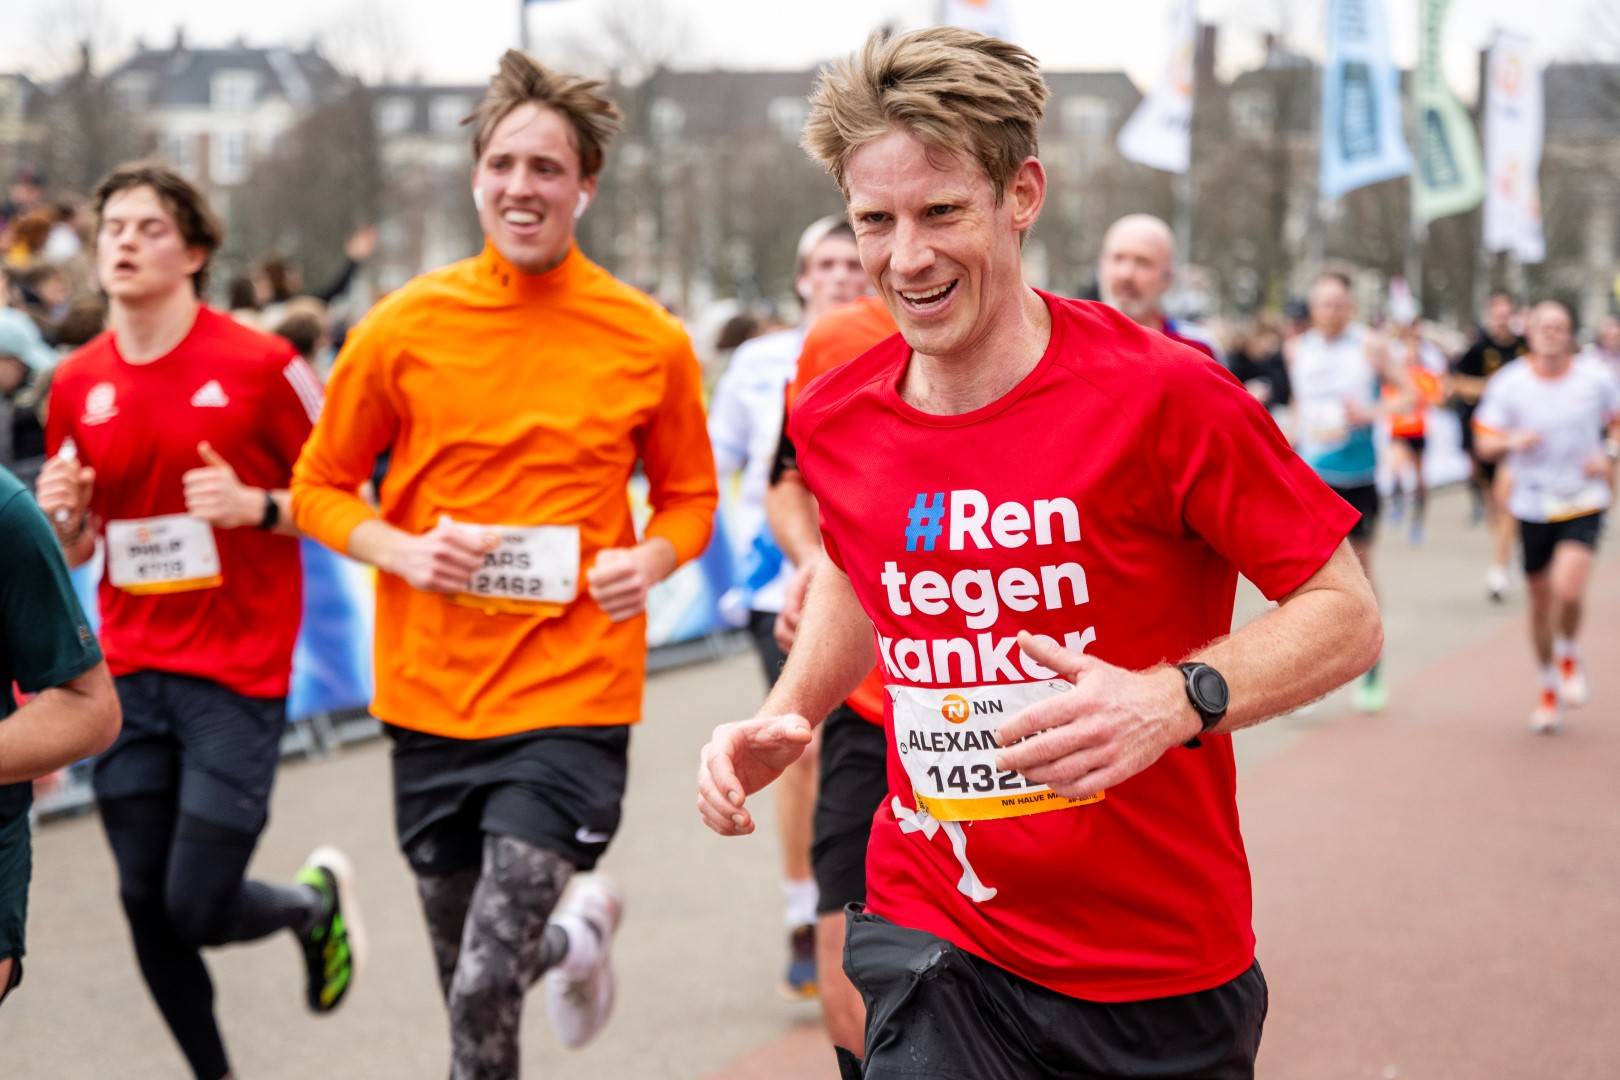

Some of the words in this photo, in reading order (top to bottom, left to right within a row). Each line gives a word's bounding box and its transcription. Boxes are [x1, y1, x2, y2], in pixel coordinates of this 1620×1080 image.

[904, 489, 1082, 552] #Ren
[483, 552, 531, 569] ARS
[880, 560, 1090, 630] tegen
[972, 699, 1004, 715] NN
[909, 728, 1058, 753] ALEXAN
[926, 763, 1047, 794] 1432
[1001, 799, 1016, 807] NN
[1017, 793, 1045, 806] HALVE
